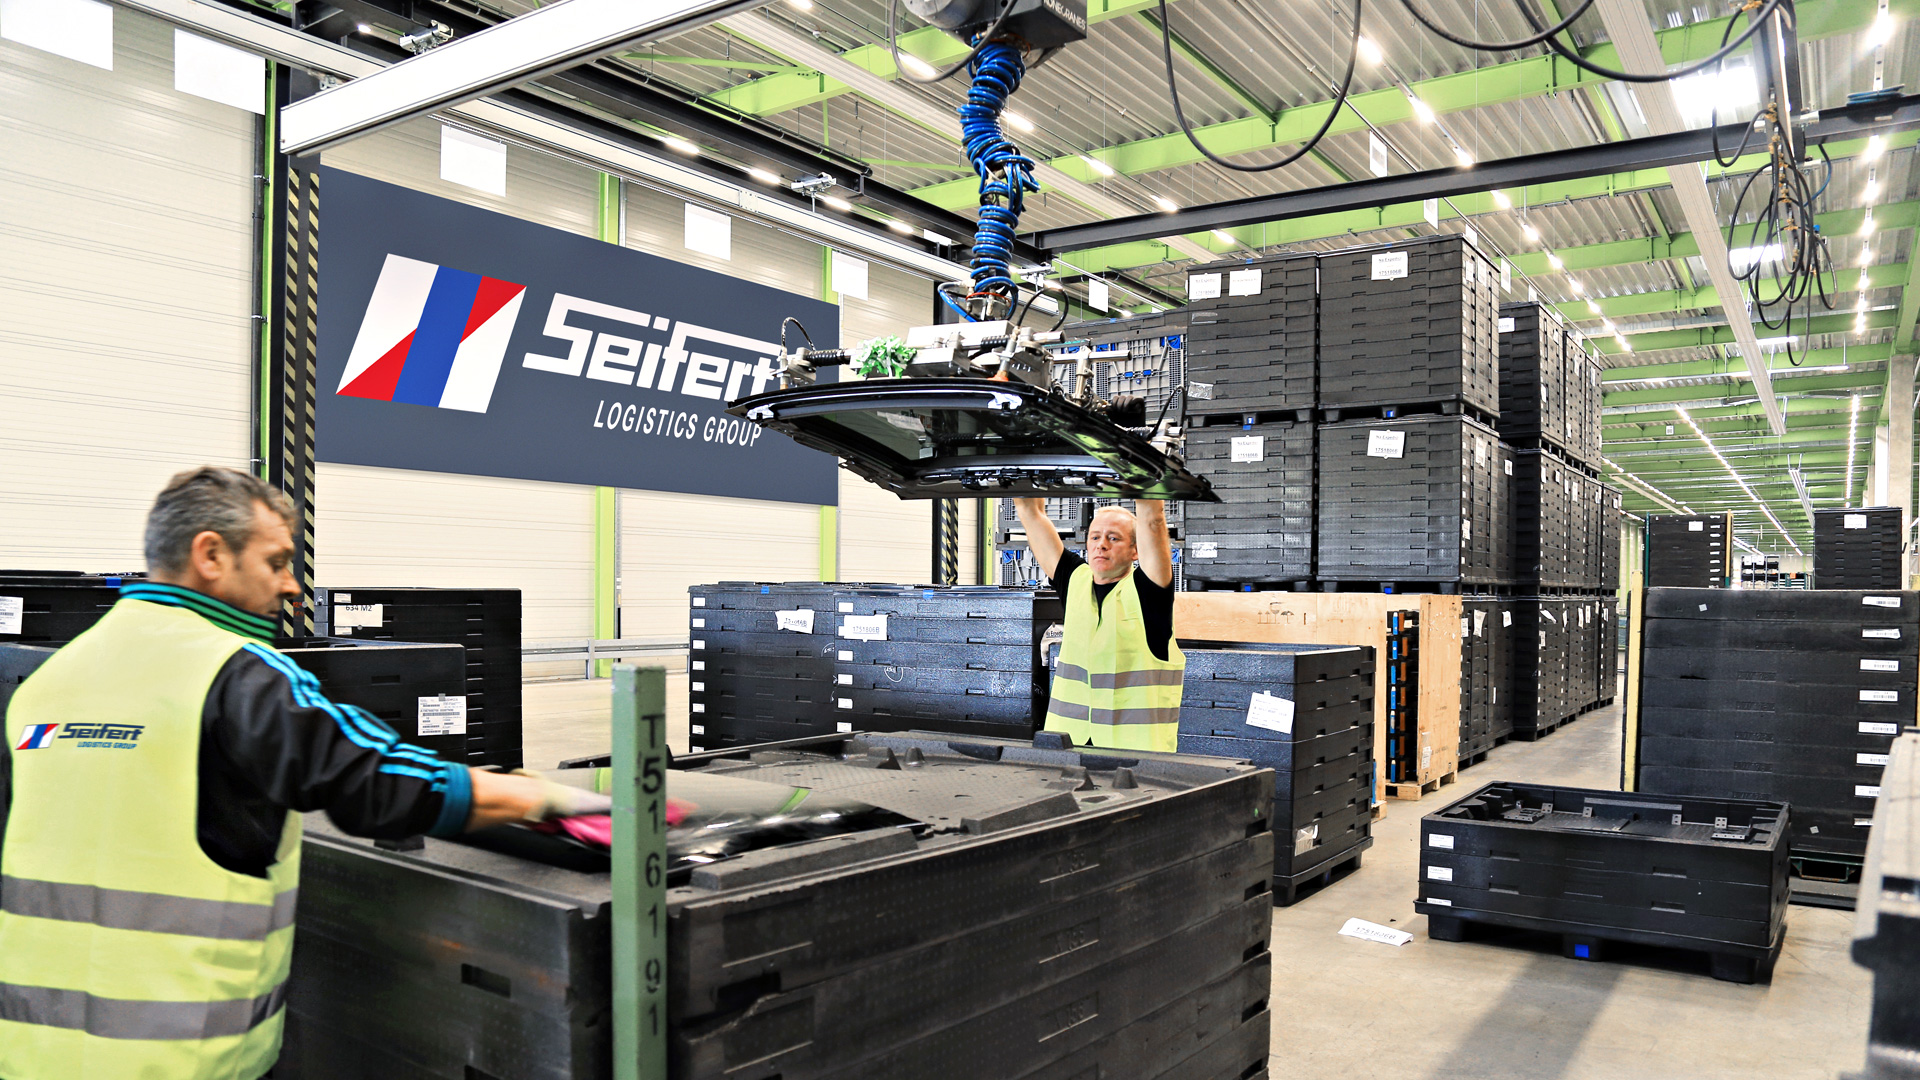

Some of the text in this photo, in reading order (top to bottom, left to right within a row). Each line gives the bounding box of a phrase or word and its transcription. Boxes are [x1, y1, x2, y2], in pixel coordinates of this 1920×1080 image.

[522, 292, 783, 402] Seifert
[593, 400, 762, 447] LOGISTICS GROUP
[57, 723, 146, 740] Seifert
